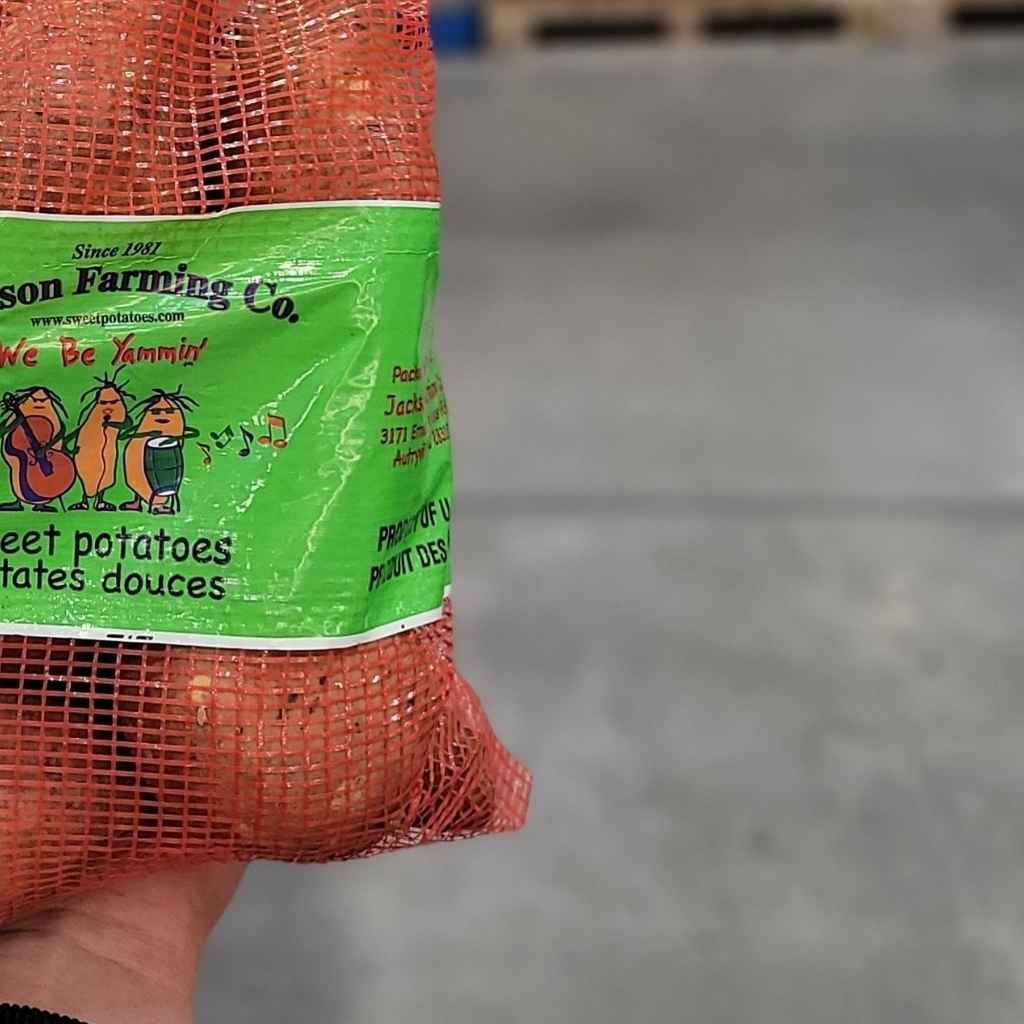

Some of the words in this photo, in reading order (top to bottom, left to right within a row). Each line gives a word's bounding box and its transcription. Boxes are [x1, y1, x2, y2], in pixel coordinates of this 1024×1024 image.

[72, 243, 119, 260] Since
[123, 241, 163, 257] 1981
[73, 262, 232, 312] Farming
[243, 278, 302, 324] Co.
[30, 311, 185, 327] www.sweetpotatoes.com
[59, 336, 96, 367] Be
[111, 333, 209, 366] Yammin'
[74, 526, 233, 567] potatoes
[416, 538, 447, 568] DES
[102, 564, 226, 600] douces
